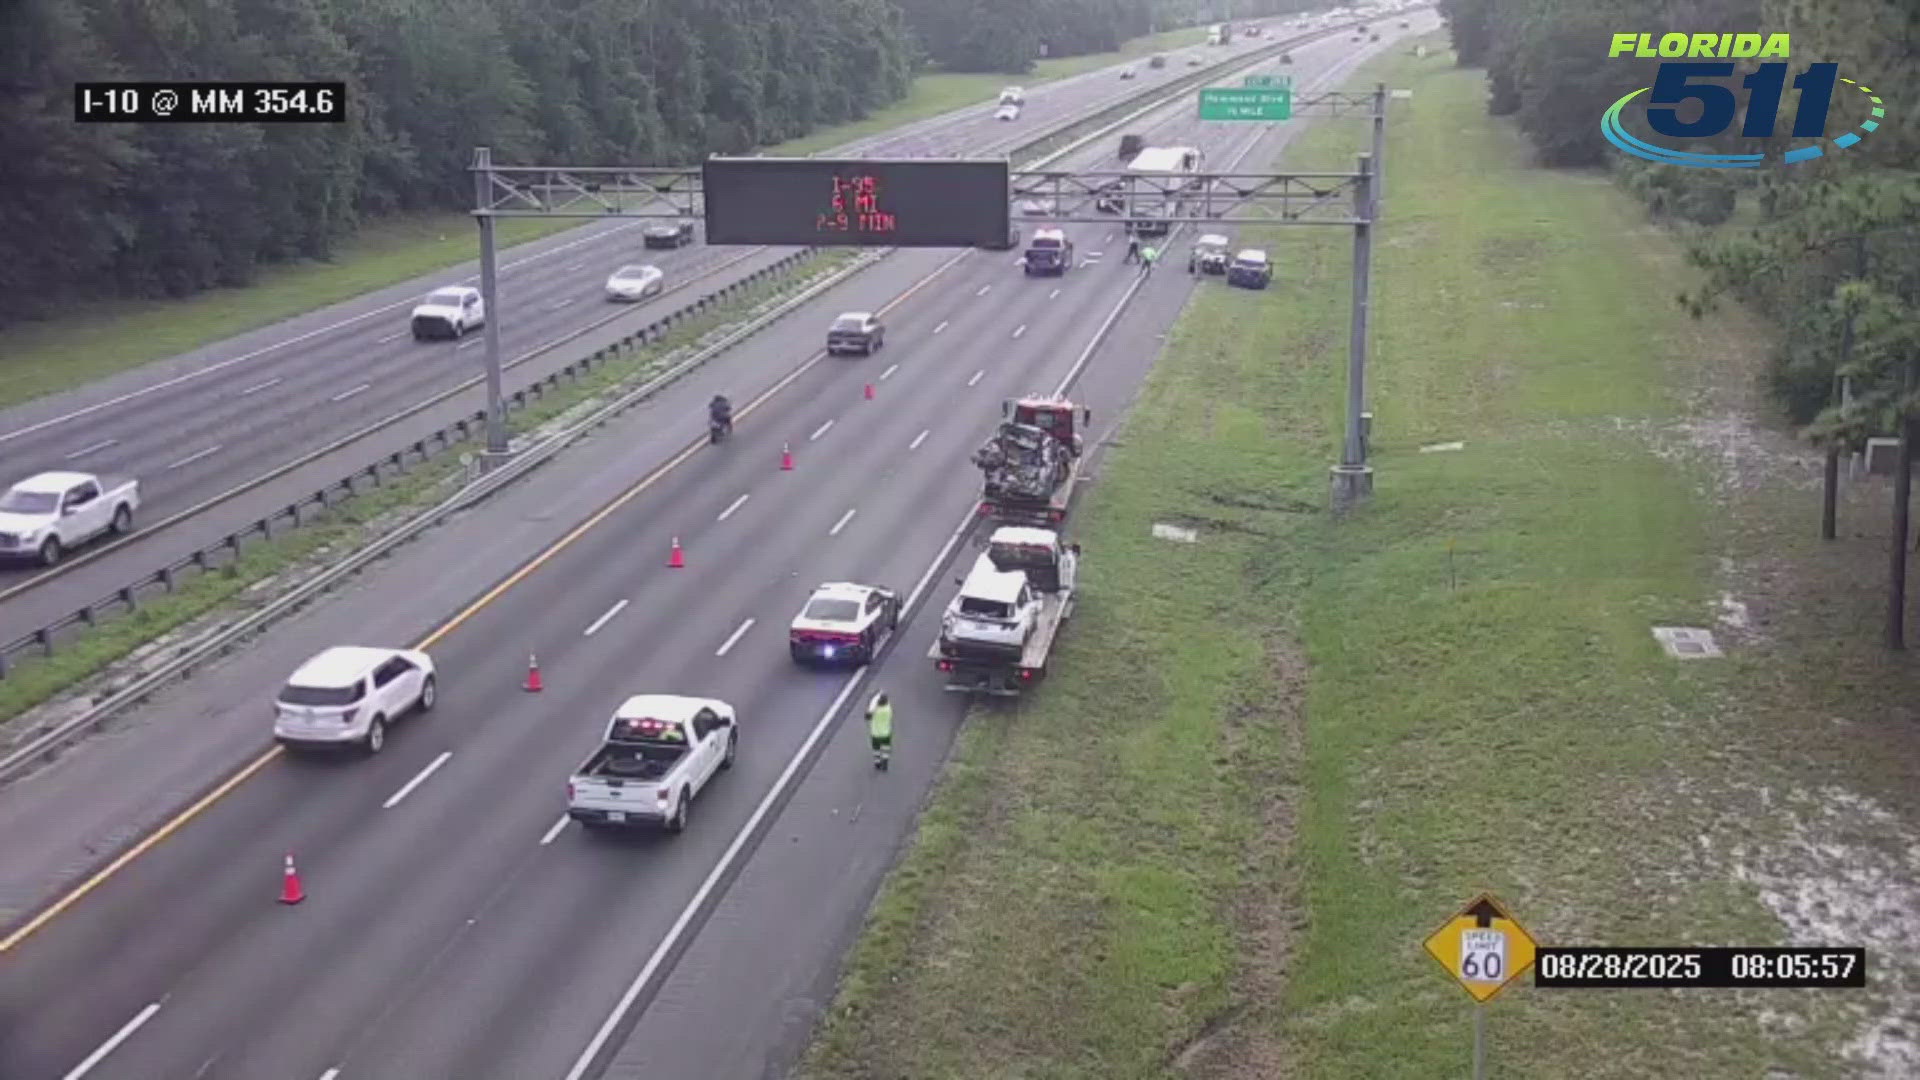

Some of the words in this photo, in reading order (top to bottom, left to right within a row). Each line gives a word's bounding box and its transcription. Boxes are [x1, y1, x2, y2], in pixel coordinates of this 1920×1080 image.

[831, 176, 876, 194] I-95
[854, 194, 878, 213] MI
[858, 213, 896, 232] MIN
[1462, 951, 1502, 978] 60
